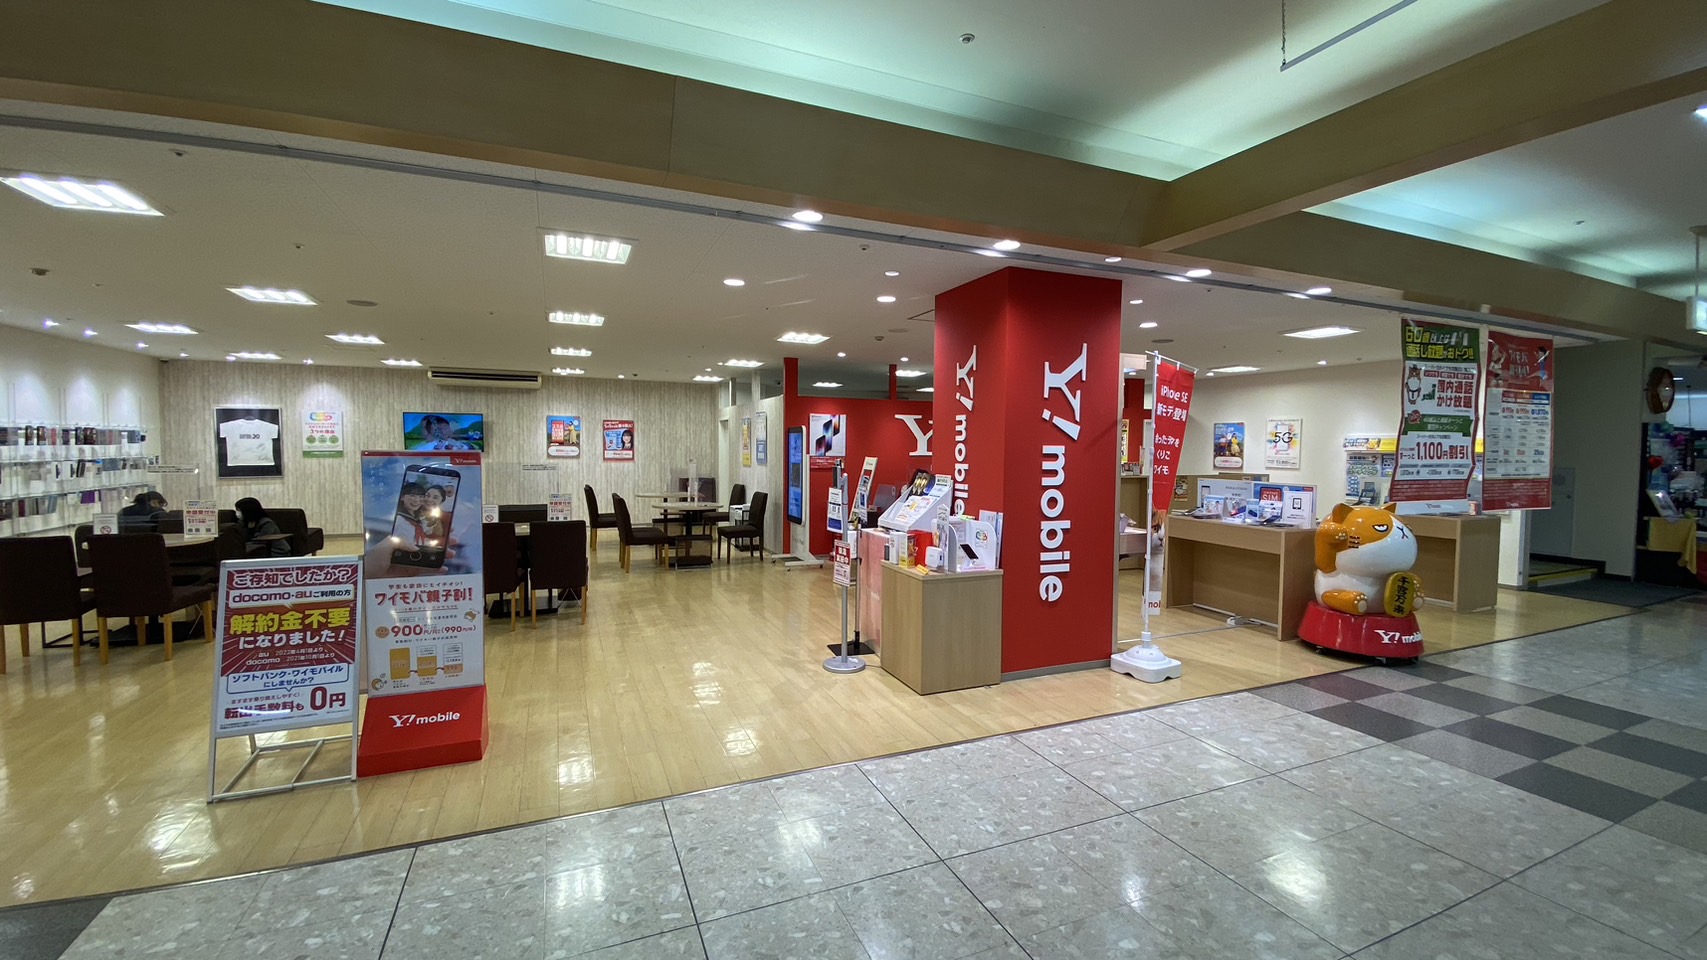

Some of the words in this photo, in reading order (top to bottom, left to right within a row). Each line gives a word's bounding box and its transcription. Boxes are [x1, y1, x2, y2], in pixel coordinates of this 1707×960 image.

[1437, 380, 1474, 394] 国内通話
[1436, 394, 1472, 408] かけ放題
[1273, 431, 1293, 444] 5G
[233, 569, 351, 587] ご存知でしたか?
[374, 587, 473, 606] ワイモバ親子割!
[230, 607, 351, 635] 解約金不要
[239, 630, 345, 649] になりました!
[246, 658, 280, 666] docomo
